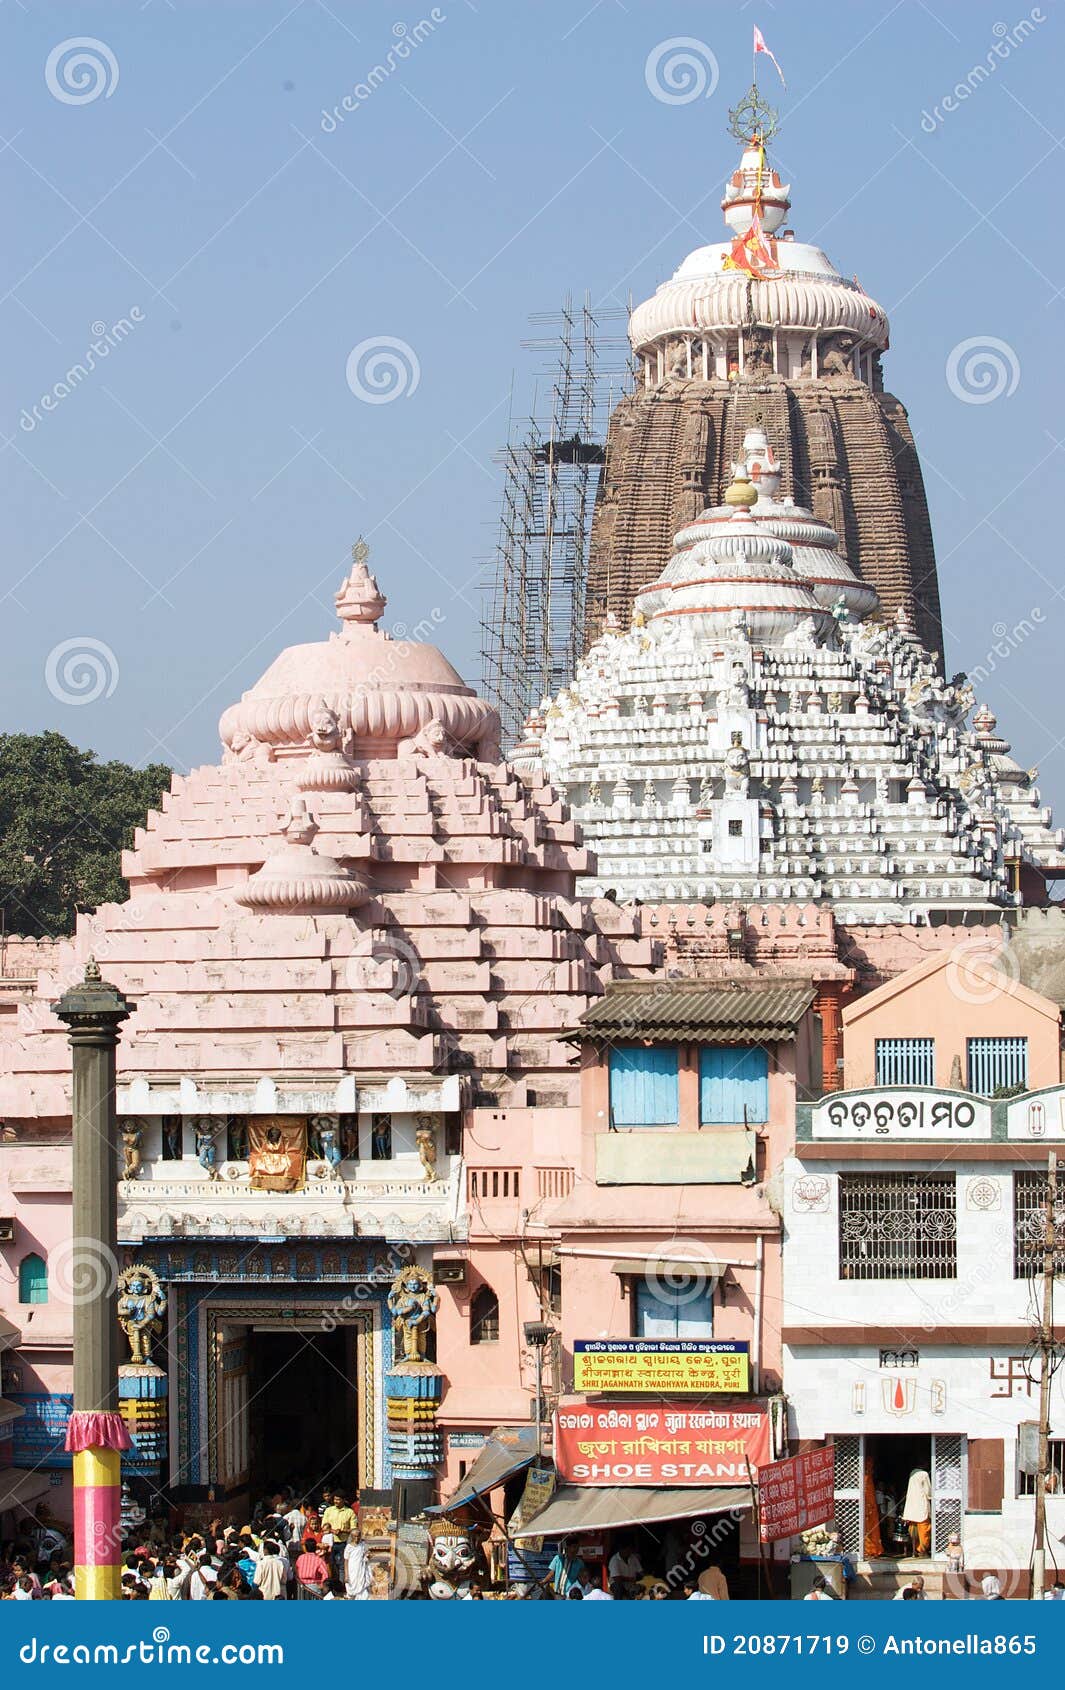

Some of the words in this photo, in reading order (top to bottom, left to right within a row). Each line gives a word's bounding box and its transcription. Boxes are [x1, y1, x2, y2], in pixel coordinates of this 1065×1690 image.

[582, 1380, 599, 1388] SHRI
[600, 1380, 643, 1388] JAGANNATH
[646, 1380, 689, 1388] SWADHYAYA
[732, 1413, 761, 1429] स्थान
[577, 1439, 618, 1459] জুতা
[620, 1436, 692, 1455] রাখিবার
[572, 1463, 652, 1478] SHOE
[661, 1463, 758, 1478] STAND
